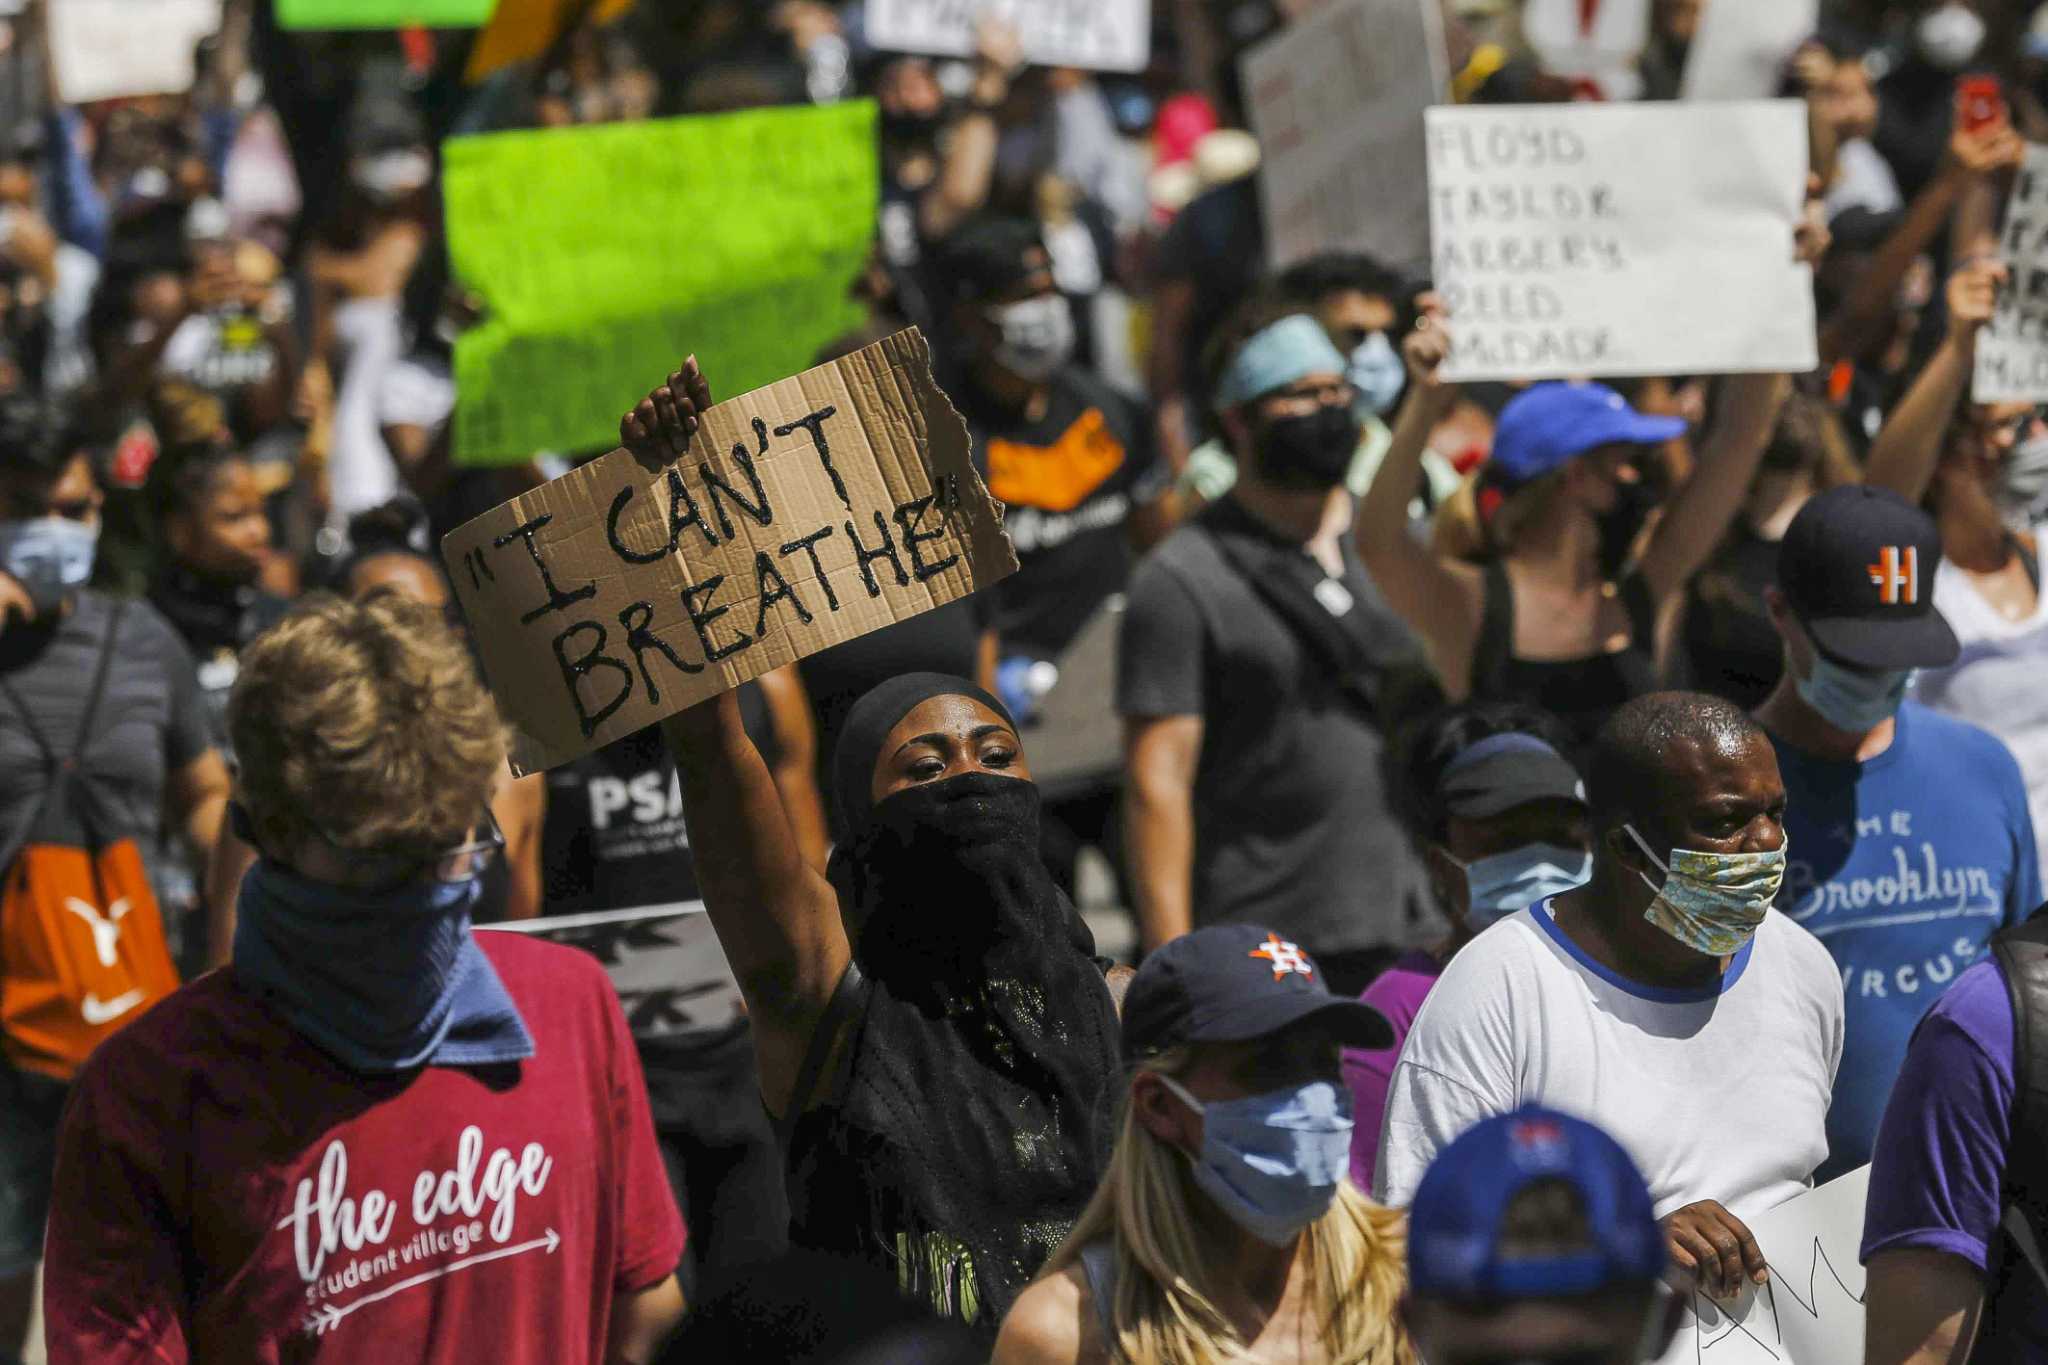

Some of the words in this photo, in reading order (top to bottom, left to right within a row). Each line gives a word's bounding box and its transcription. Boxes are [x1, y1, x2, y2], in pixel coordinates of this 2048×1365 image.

[1434, 123, 1585, 171] FLOYD
[1438, 183, 1617, 224] TAYLOR
[606, 405, 851, 564] CAN'T
[276, 1139, 397, 1281] the
[412, 1125, 553, 1243] edge
[400, 1220, 484, 1265] village
